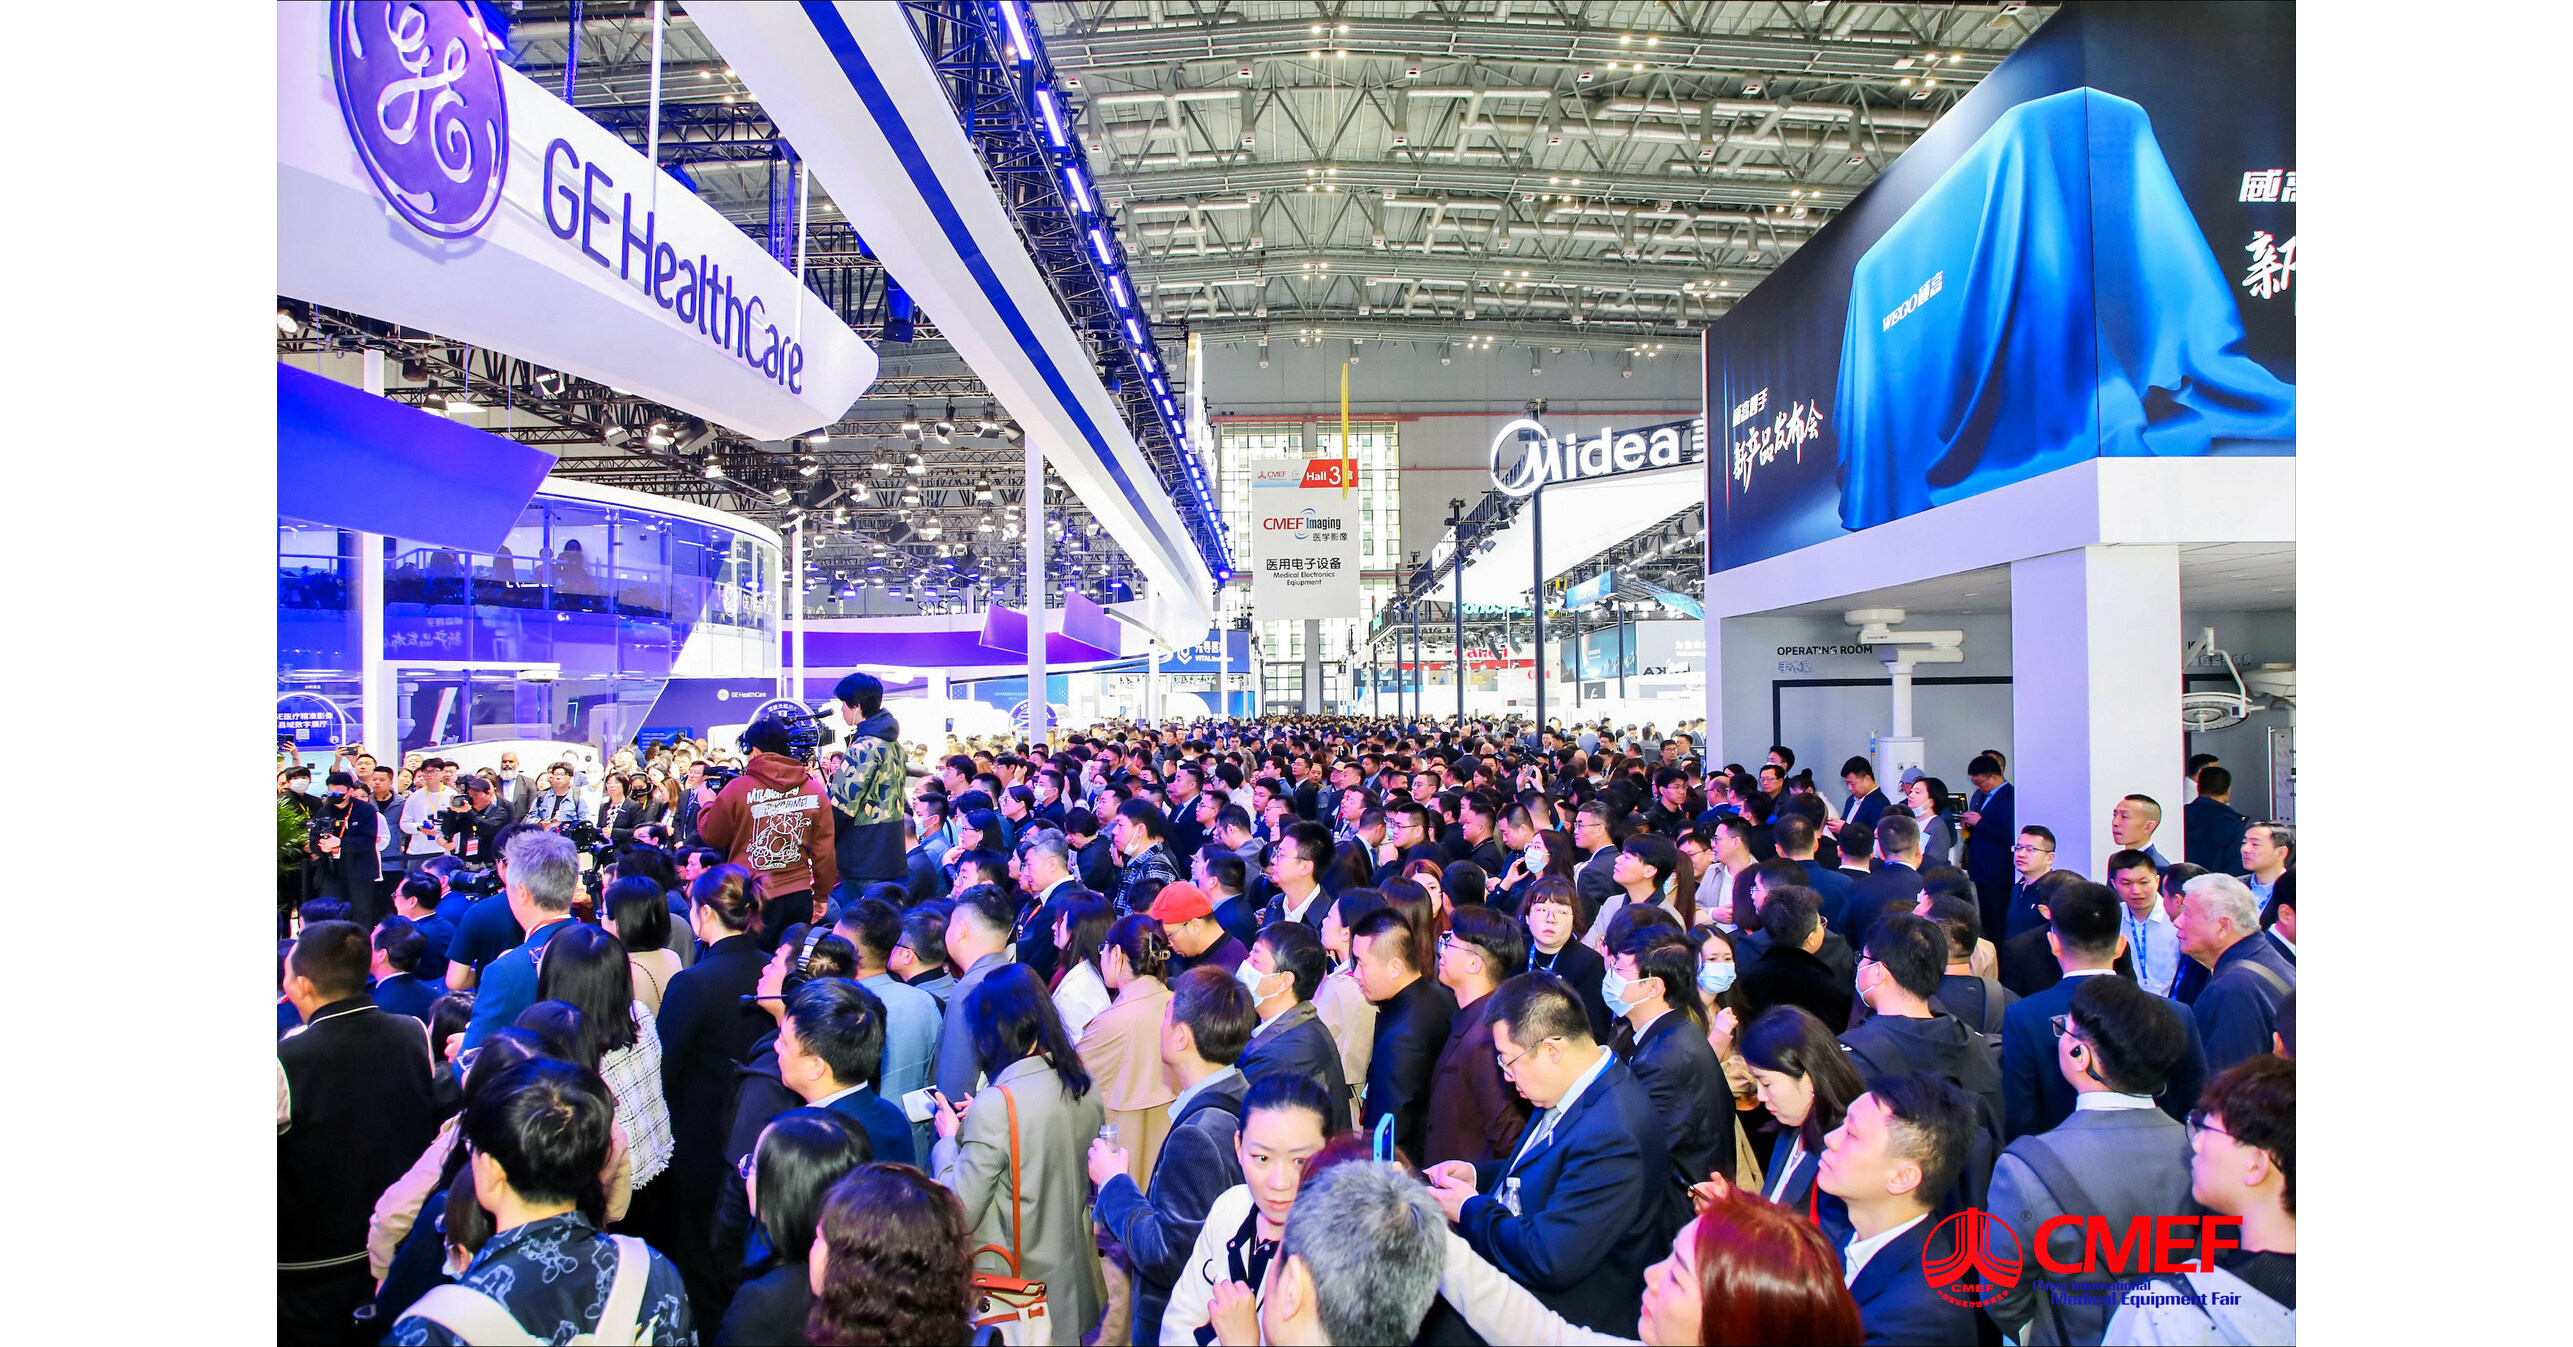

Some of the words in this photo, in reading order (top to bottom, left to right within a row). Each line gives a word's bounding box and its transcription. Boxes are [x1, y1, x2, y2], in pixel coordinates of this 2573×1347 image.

[542, 137, 614, 268] GE
[620, 191, 803, 395] HealthCare
[1732, 398, 1825, 494] 新产品发布会
[1497, 423, 1680, 494] Midea
[1267, 470, 1287, 478] CMEF
[1306, 471, 1327, 481] Hall
[1328, 465, 1341, 486] 3
[1263, 517, 1304, 530] CMEF
[1306, 516, 1341, 530] Imaging
[1312, 532, 1348, 542] 医学影像
[1266, 557, 1341, 571] 医用电子设备
[1777, 645, 1838, 656] OPERATING
[1840, 645, 1873, 655] ROOM
